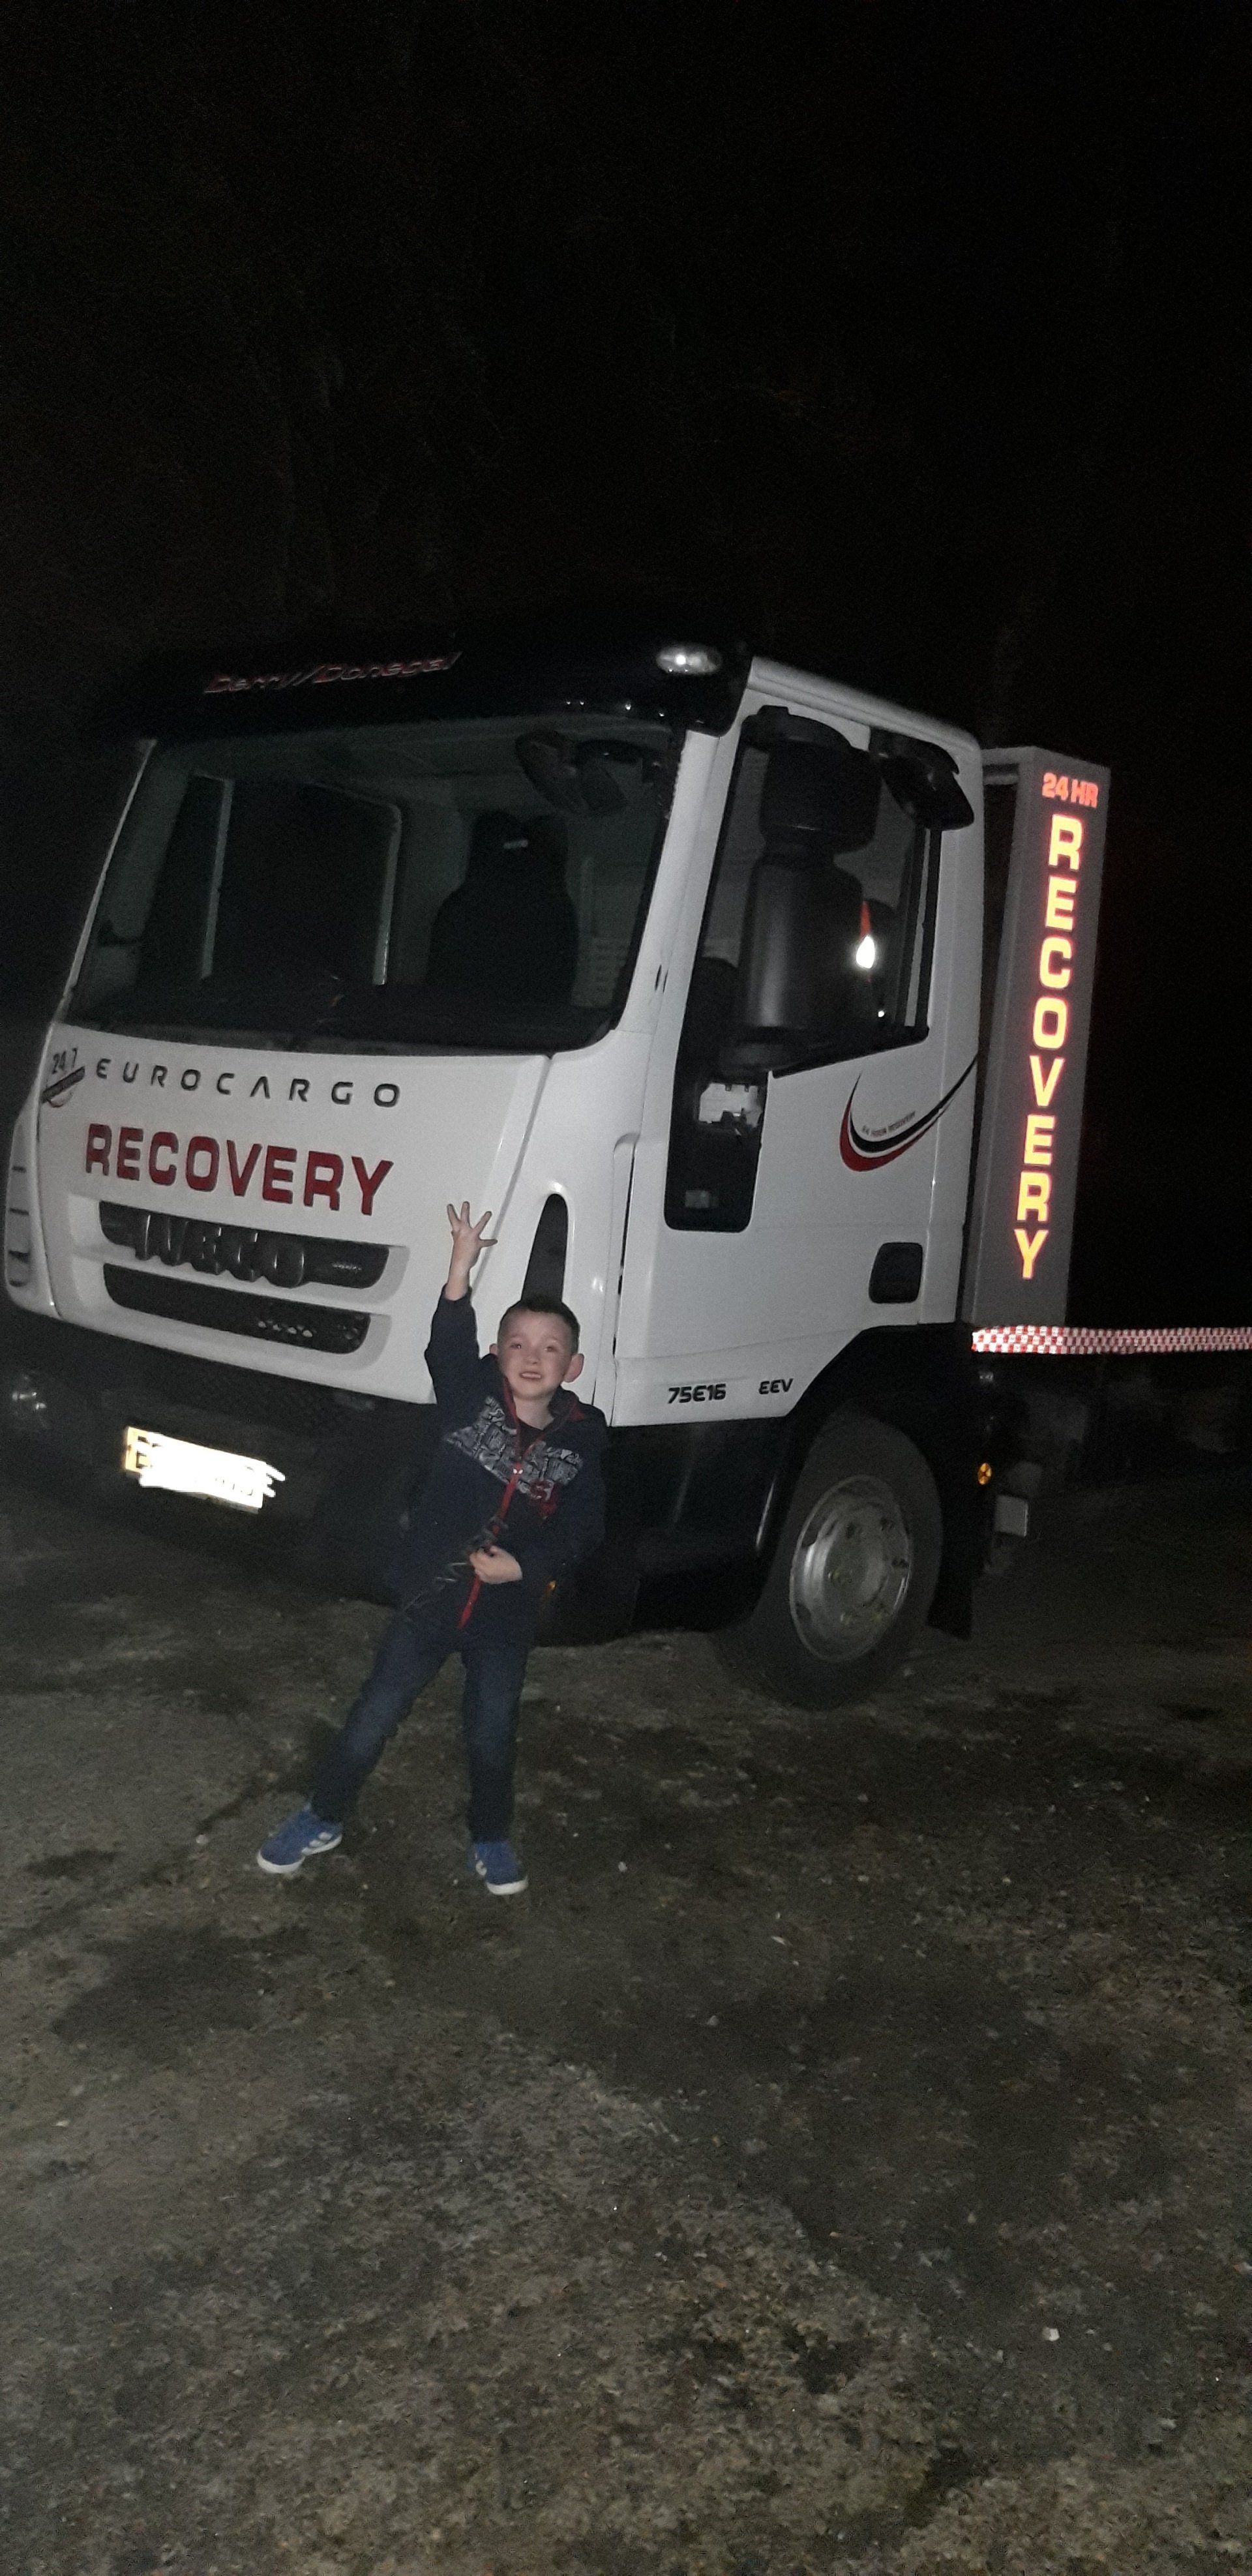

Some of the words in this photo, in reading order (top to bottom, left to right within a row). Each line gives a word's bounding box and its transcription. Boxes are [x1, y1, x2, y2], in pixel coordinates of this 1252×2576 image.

[1042, 772, 1069, 801] 24
[1071, 779, 1099, 808] HR
[1014, 813, 1084, 1280] RECOVERY
[95, 1058, 401, 1108] EUROCARGO
[85, 1123, 395, 1216] RECOVERY
[667, 1383, 727, 1404] 75E16
[758, 1377, 794, 1395] EEV
